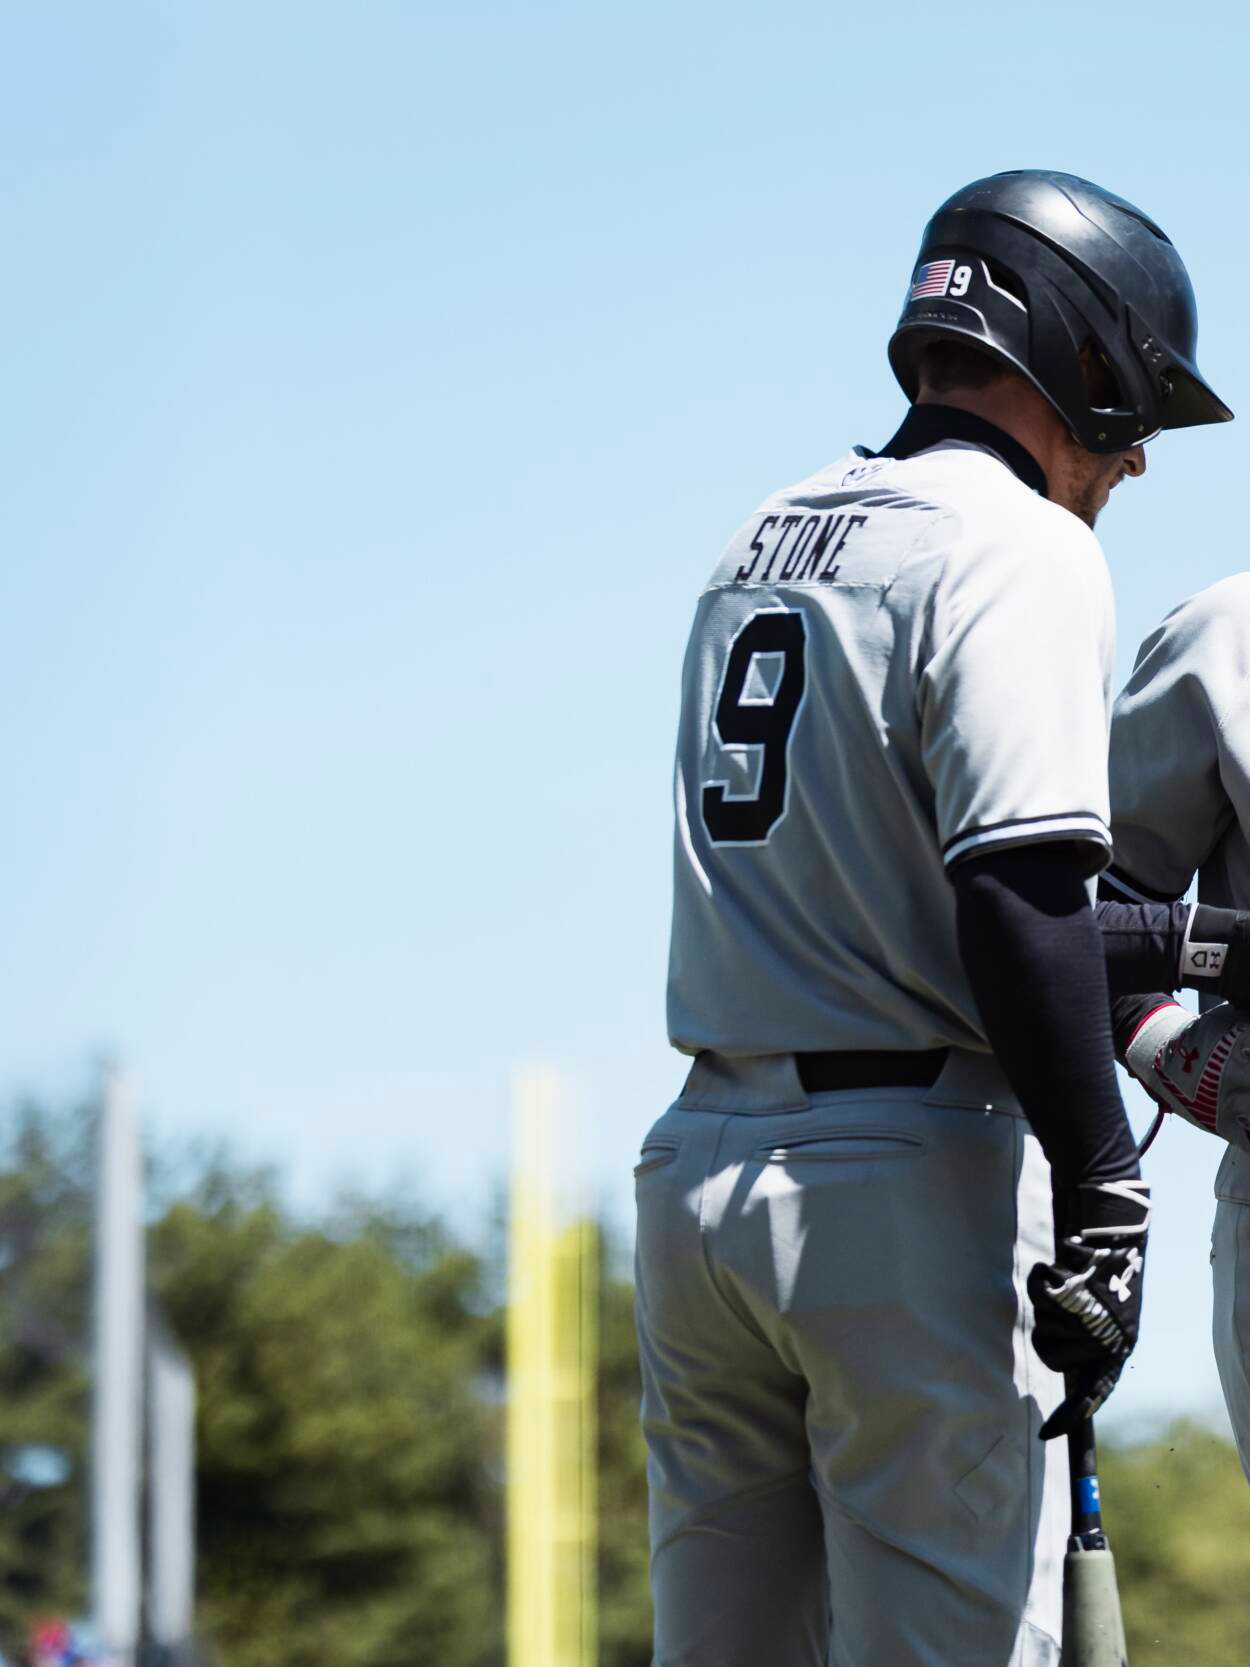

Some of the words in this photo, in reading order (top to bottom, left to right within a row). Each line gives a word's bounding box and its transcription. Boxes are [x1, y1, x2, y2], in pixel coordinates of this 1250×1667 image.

[949, 265, 973, 297] 9
[734, 514, 868, 582] STONE
[701, 607, 811, 848] 9
